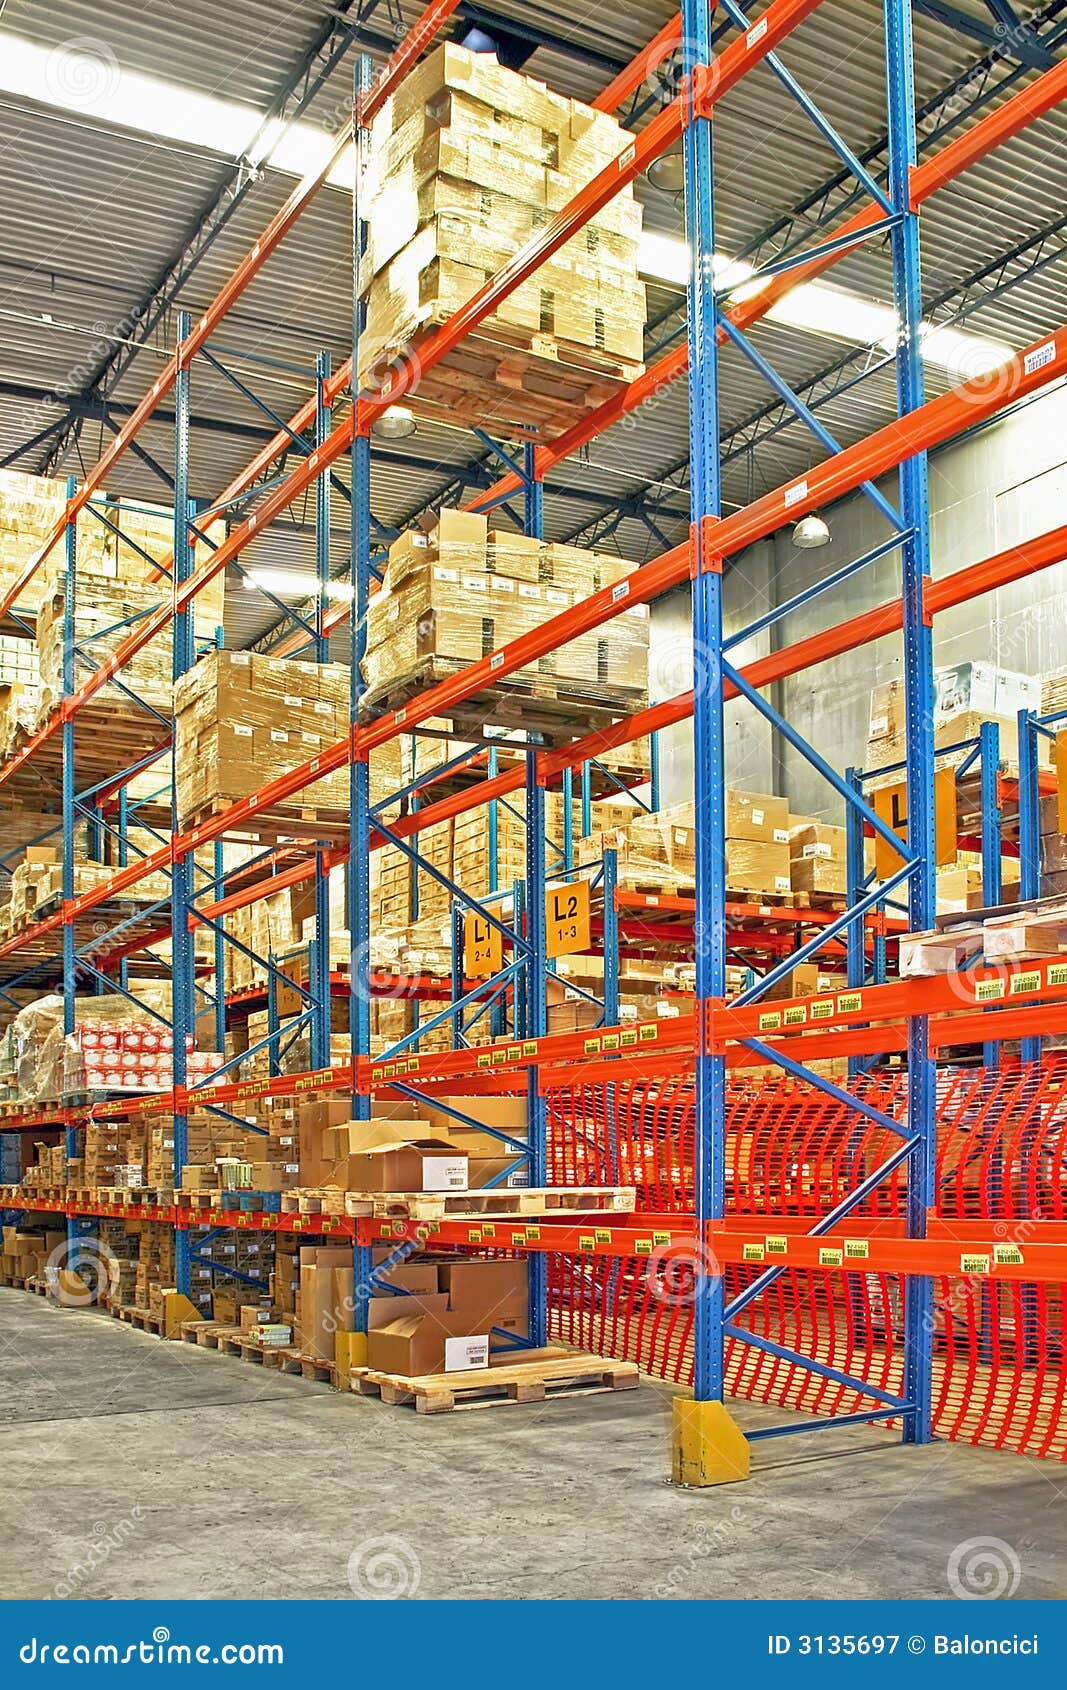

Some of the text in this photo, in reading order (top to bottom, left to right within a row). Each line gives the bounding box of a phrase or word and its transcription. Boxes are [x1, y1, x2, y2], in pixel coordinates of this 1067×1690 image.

[554, 895, 578, 922] L2
[474, 919, 491, 943] L1
[557, 926, 577, 941] 1-3
[474, 948, 491, 961] 2-4
